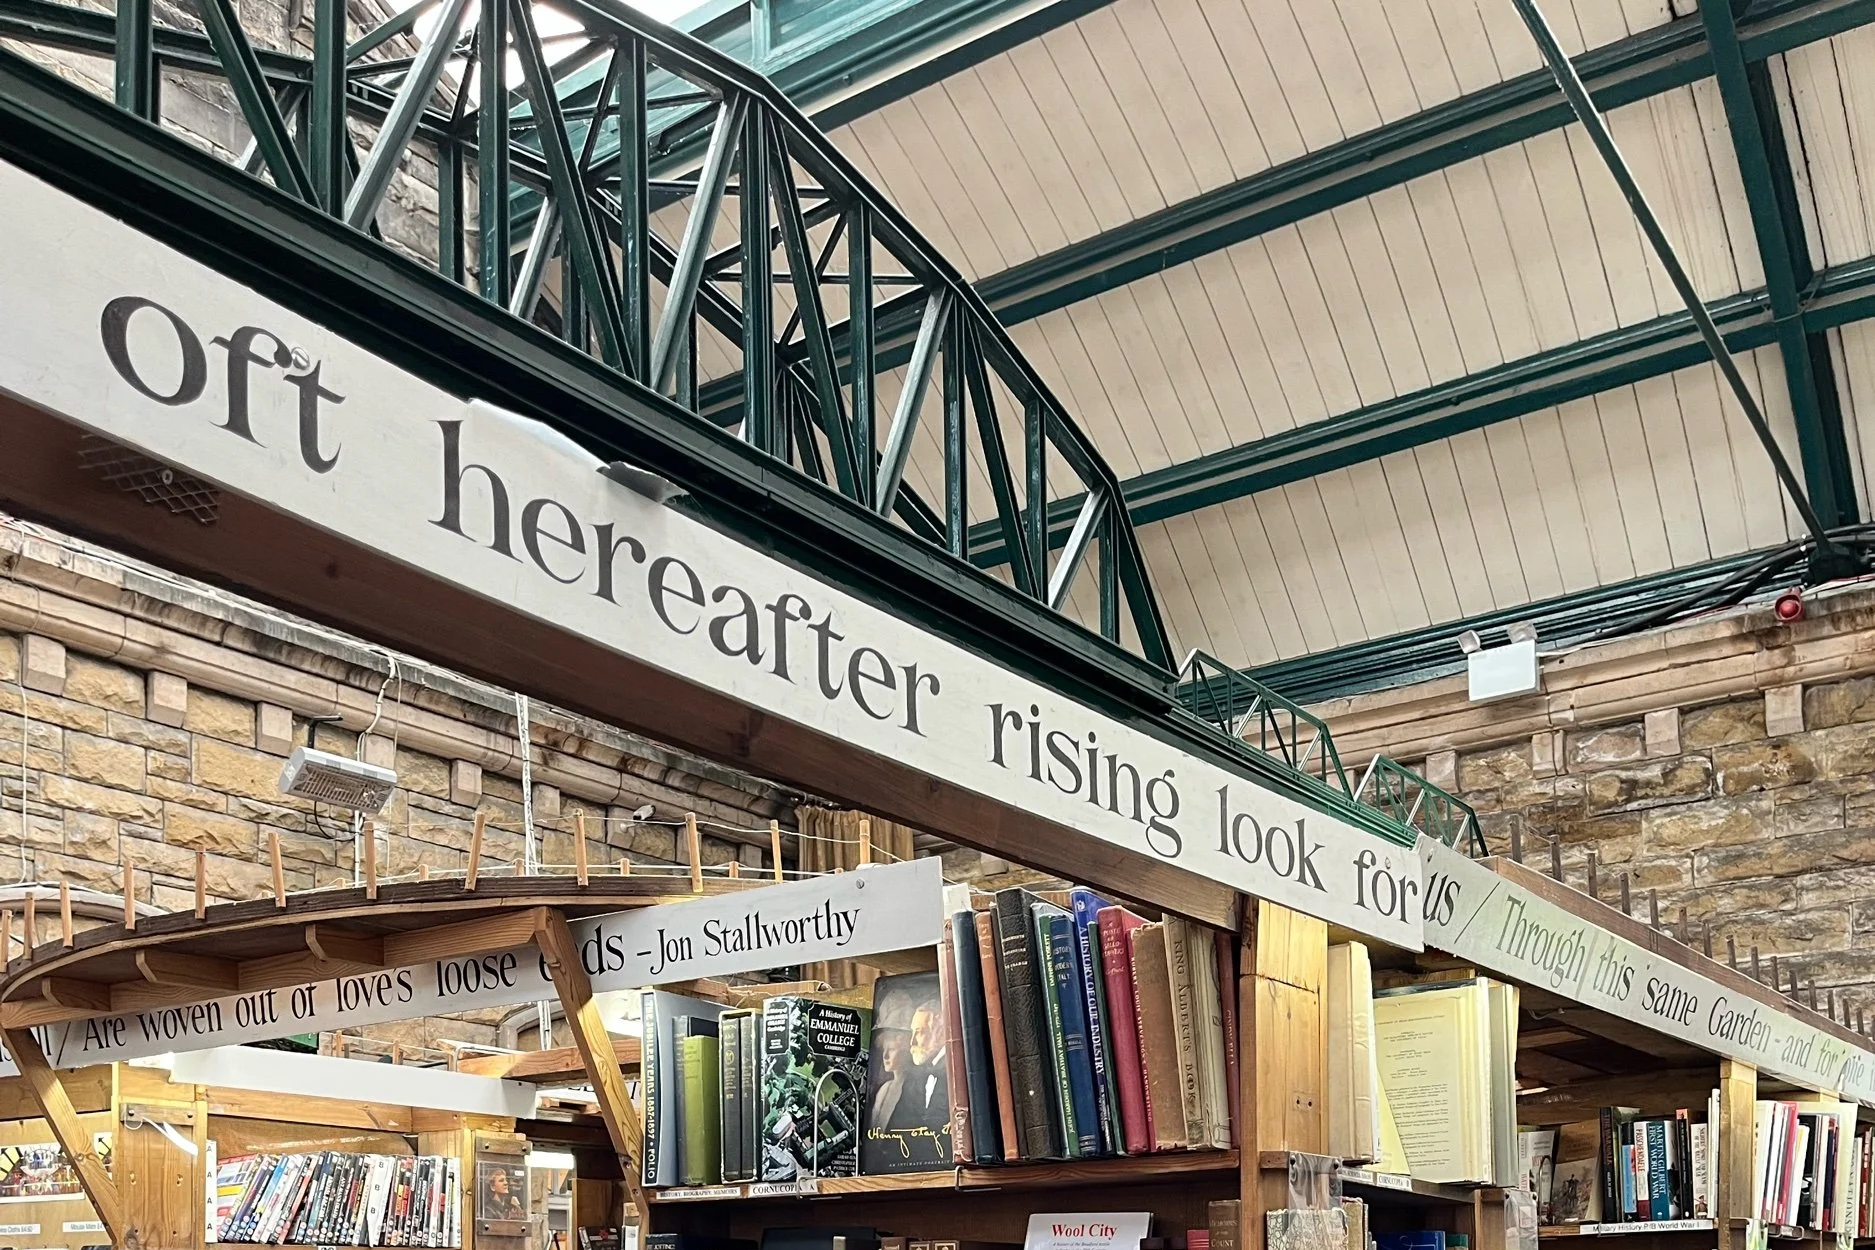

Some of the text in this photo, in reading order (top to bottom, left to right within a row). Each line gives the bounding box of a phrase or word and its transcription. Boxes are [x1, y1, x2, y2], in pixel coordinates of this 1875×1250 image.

[100, 295, 1419, 923] oft hereafter rising look for
[1173, 940, 1186, 975] KING
[82, 1015, 127, 1052] Are
[137, 999, 222, 1042] woven
[235, 988, 277, 1028] out
[290, 982, 318, 1017] of
[436, 947, 518, 998] loose
[540, 924, 626, 982] eds
[703, 899, 861, 958] Stallworthy
[1422, 871, 1462, 926] us
[1495, 894, 1586, 990] Through
[1596, 940, 1636, 1002] this
[1641, 972, 1698, 1027] same
[1708, 996, 1771, 1053] Garden
[1781, 1033, 1816, 1068] and
[1815, 1037, 1839, 1079] for
[824, 1010, 844, 1020] History
[844, 1013, 853, 1022] of
[1178, 983, 1193, 1052] ALBERT'S
[809, 1018, 860, 1035] EMMANUEL
[816, 1032, 856, 1047] COLLEGE
[206, 1145, 213, 1153] A
[1656, 1124, 1666, 1195] MARTIN GILBERT
[206, 1171, 213, 1179] A
[1051, 1223, 1118, 1240] Wool City
[1210, 1238, 1234, 1248] COUNT
